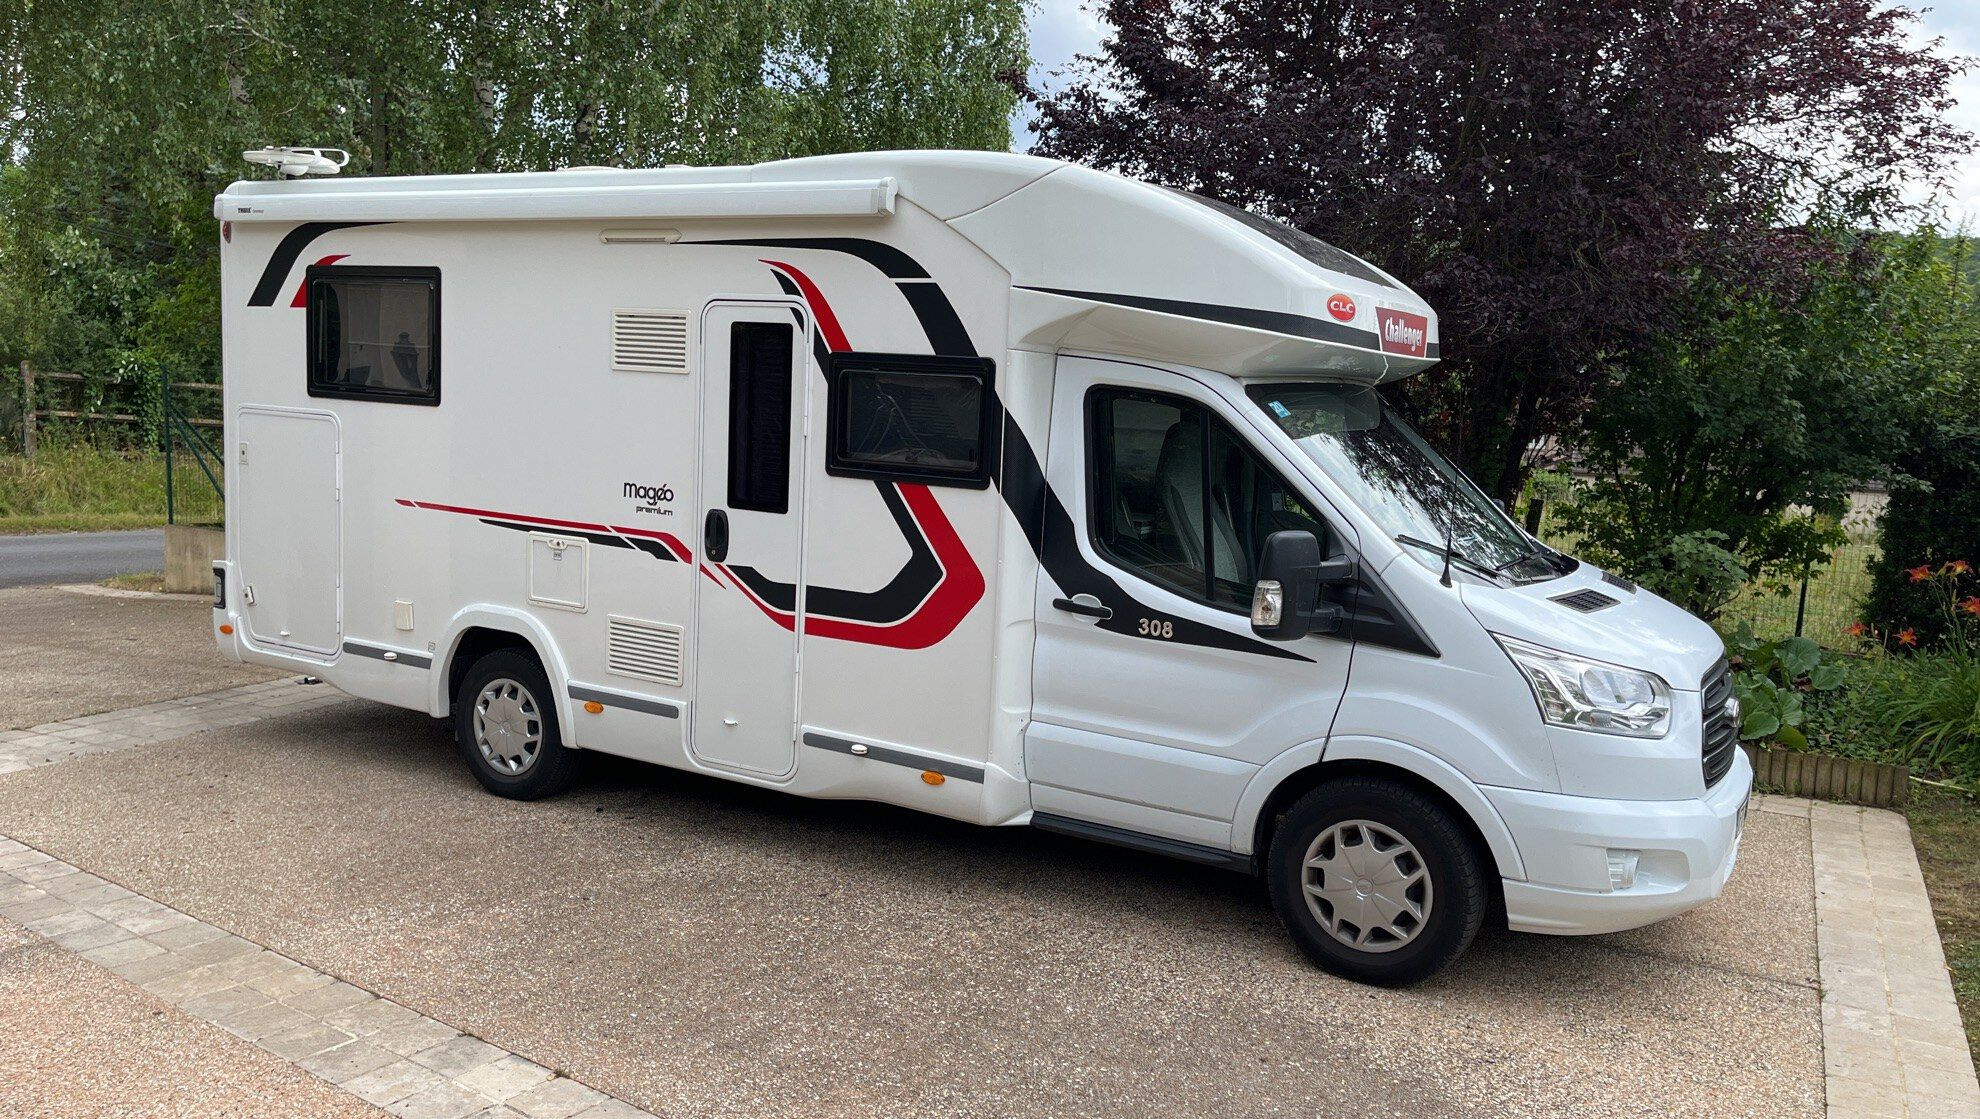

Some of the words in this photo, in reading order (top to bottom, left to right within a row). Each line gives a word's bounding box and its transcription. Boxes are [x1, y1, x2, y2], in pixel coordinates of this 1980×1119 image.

[1330, 300, 1354, 314] CLC
[1385, 316, 1423, 352] Challenger
[1138, 618, 1173, 639] 308
